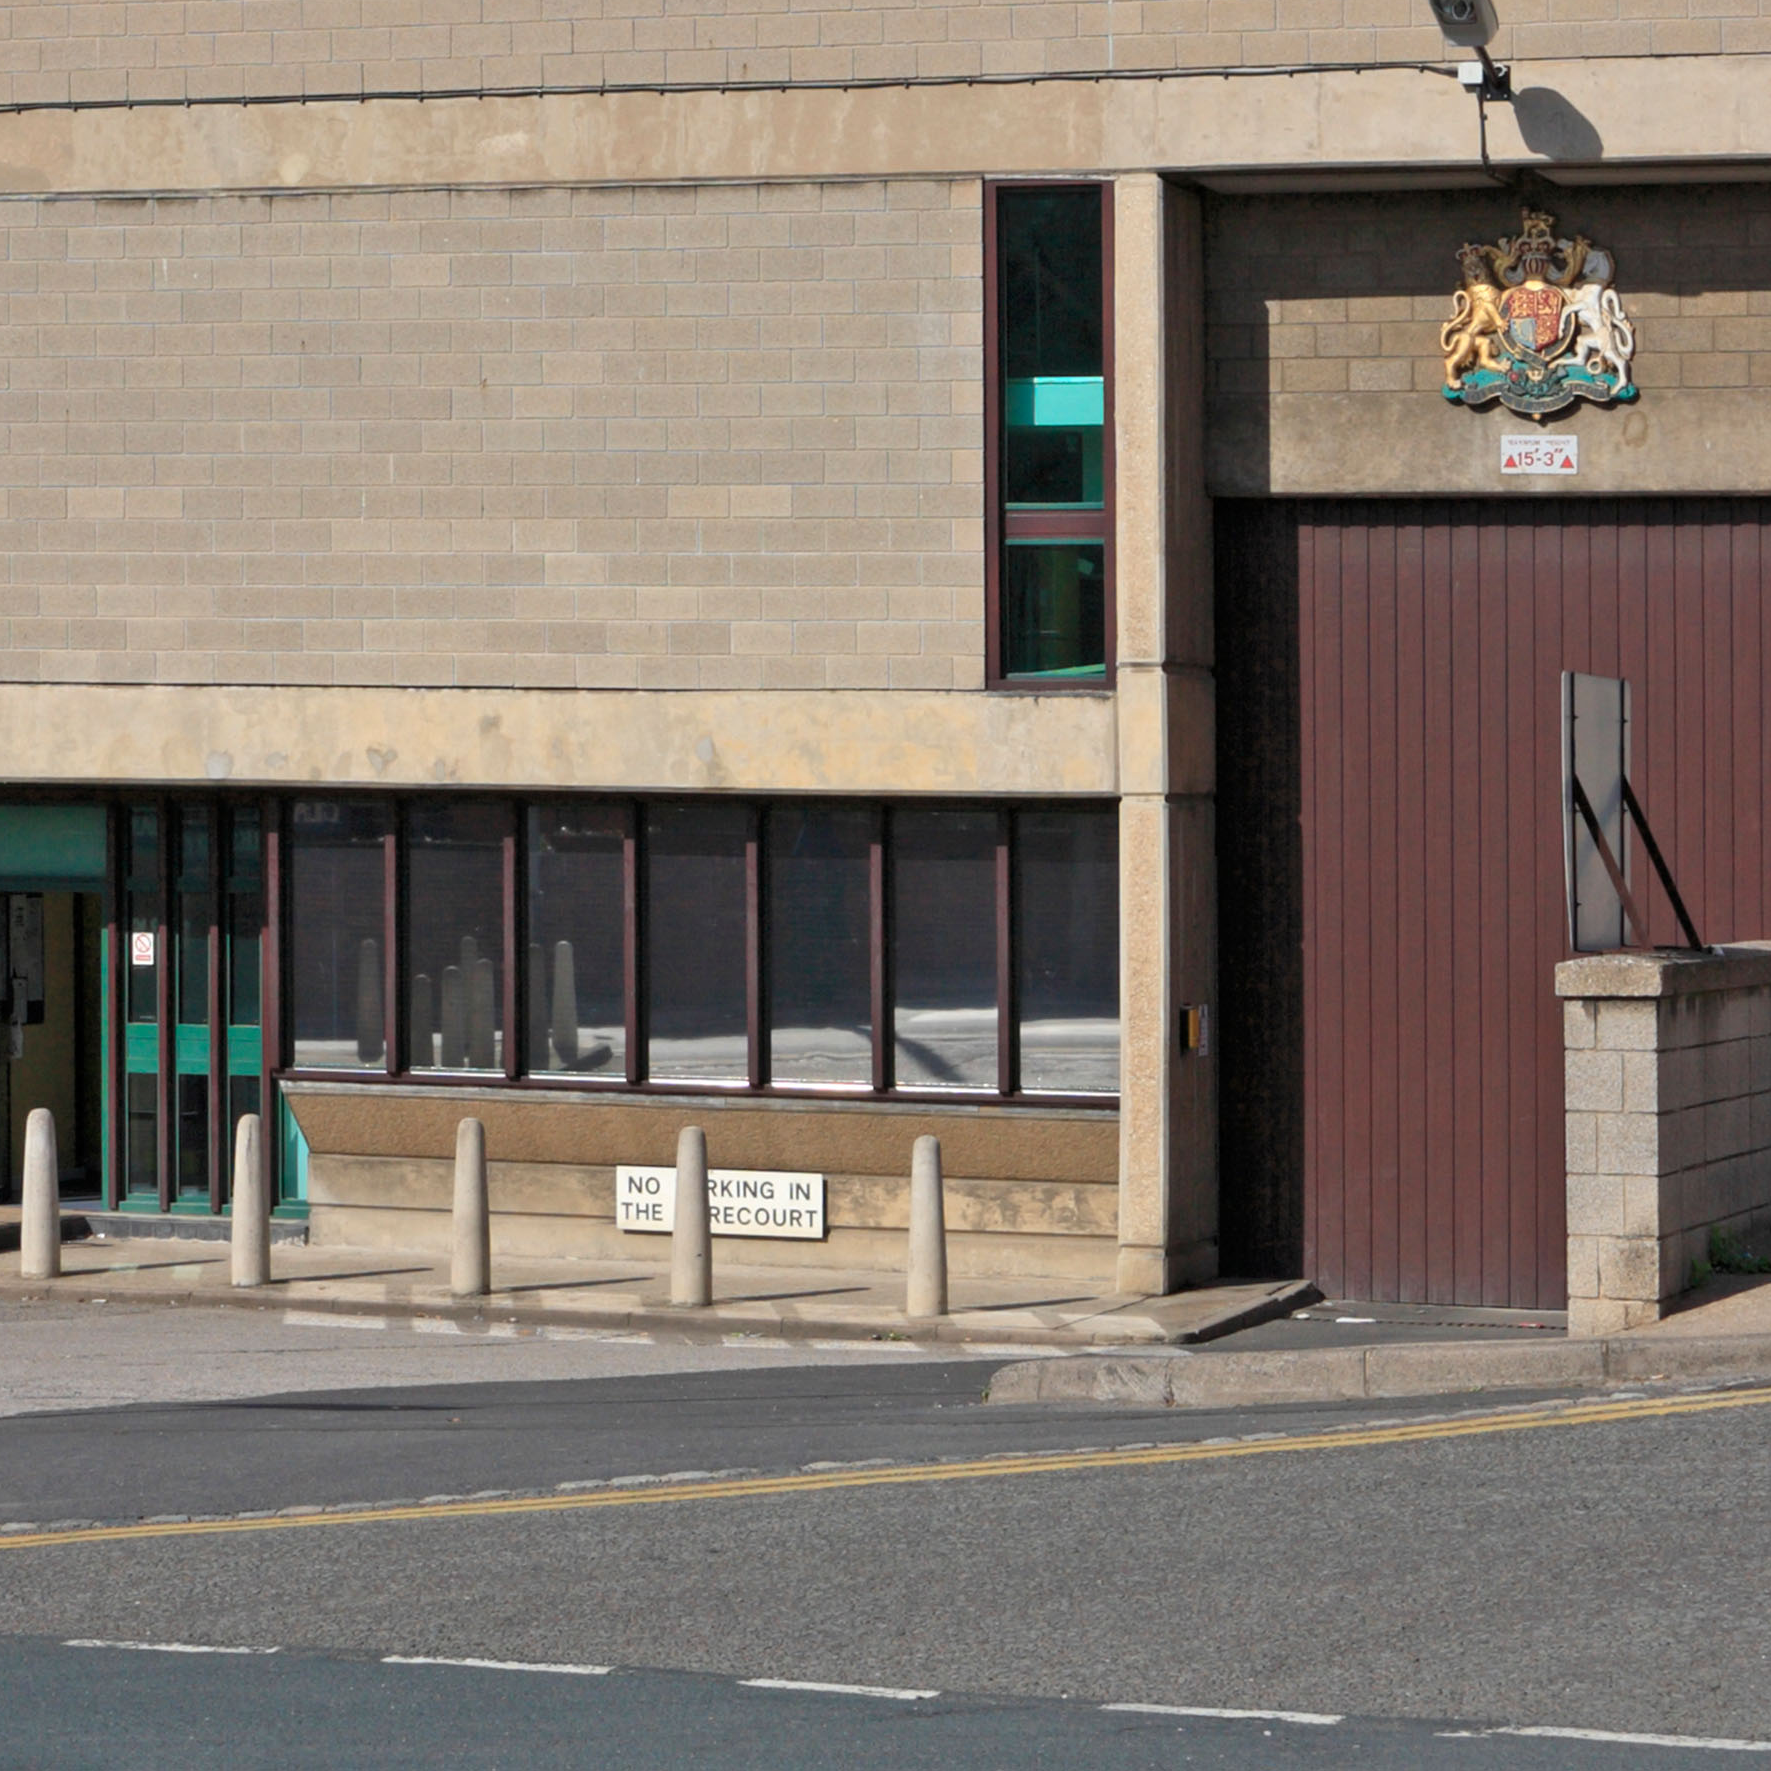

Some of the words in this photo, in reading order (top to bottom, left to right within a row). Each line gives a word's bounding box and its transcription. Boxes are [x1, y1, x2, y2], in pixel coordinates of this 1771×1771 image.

[628, 1176, 660, 1195] NO
[707, 1179, 775, 1200] RKING
[789, 1182, 811, 1201] IN
[621, 1202, 664, 1221] THE
[709, 1206, 818, 1229] RECOURT
